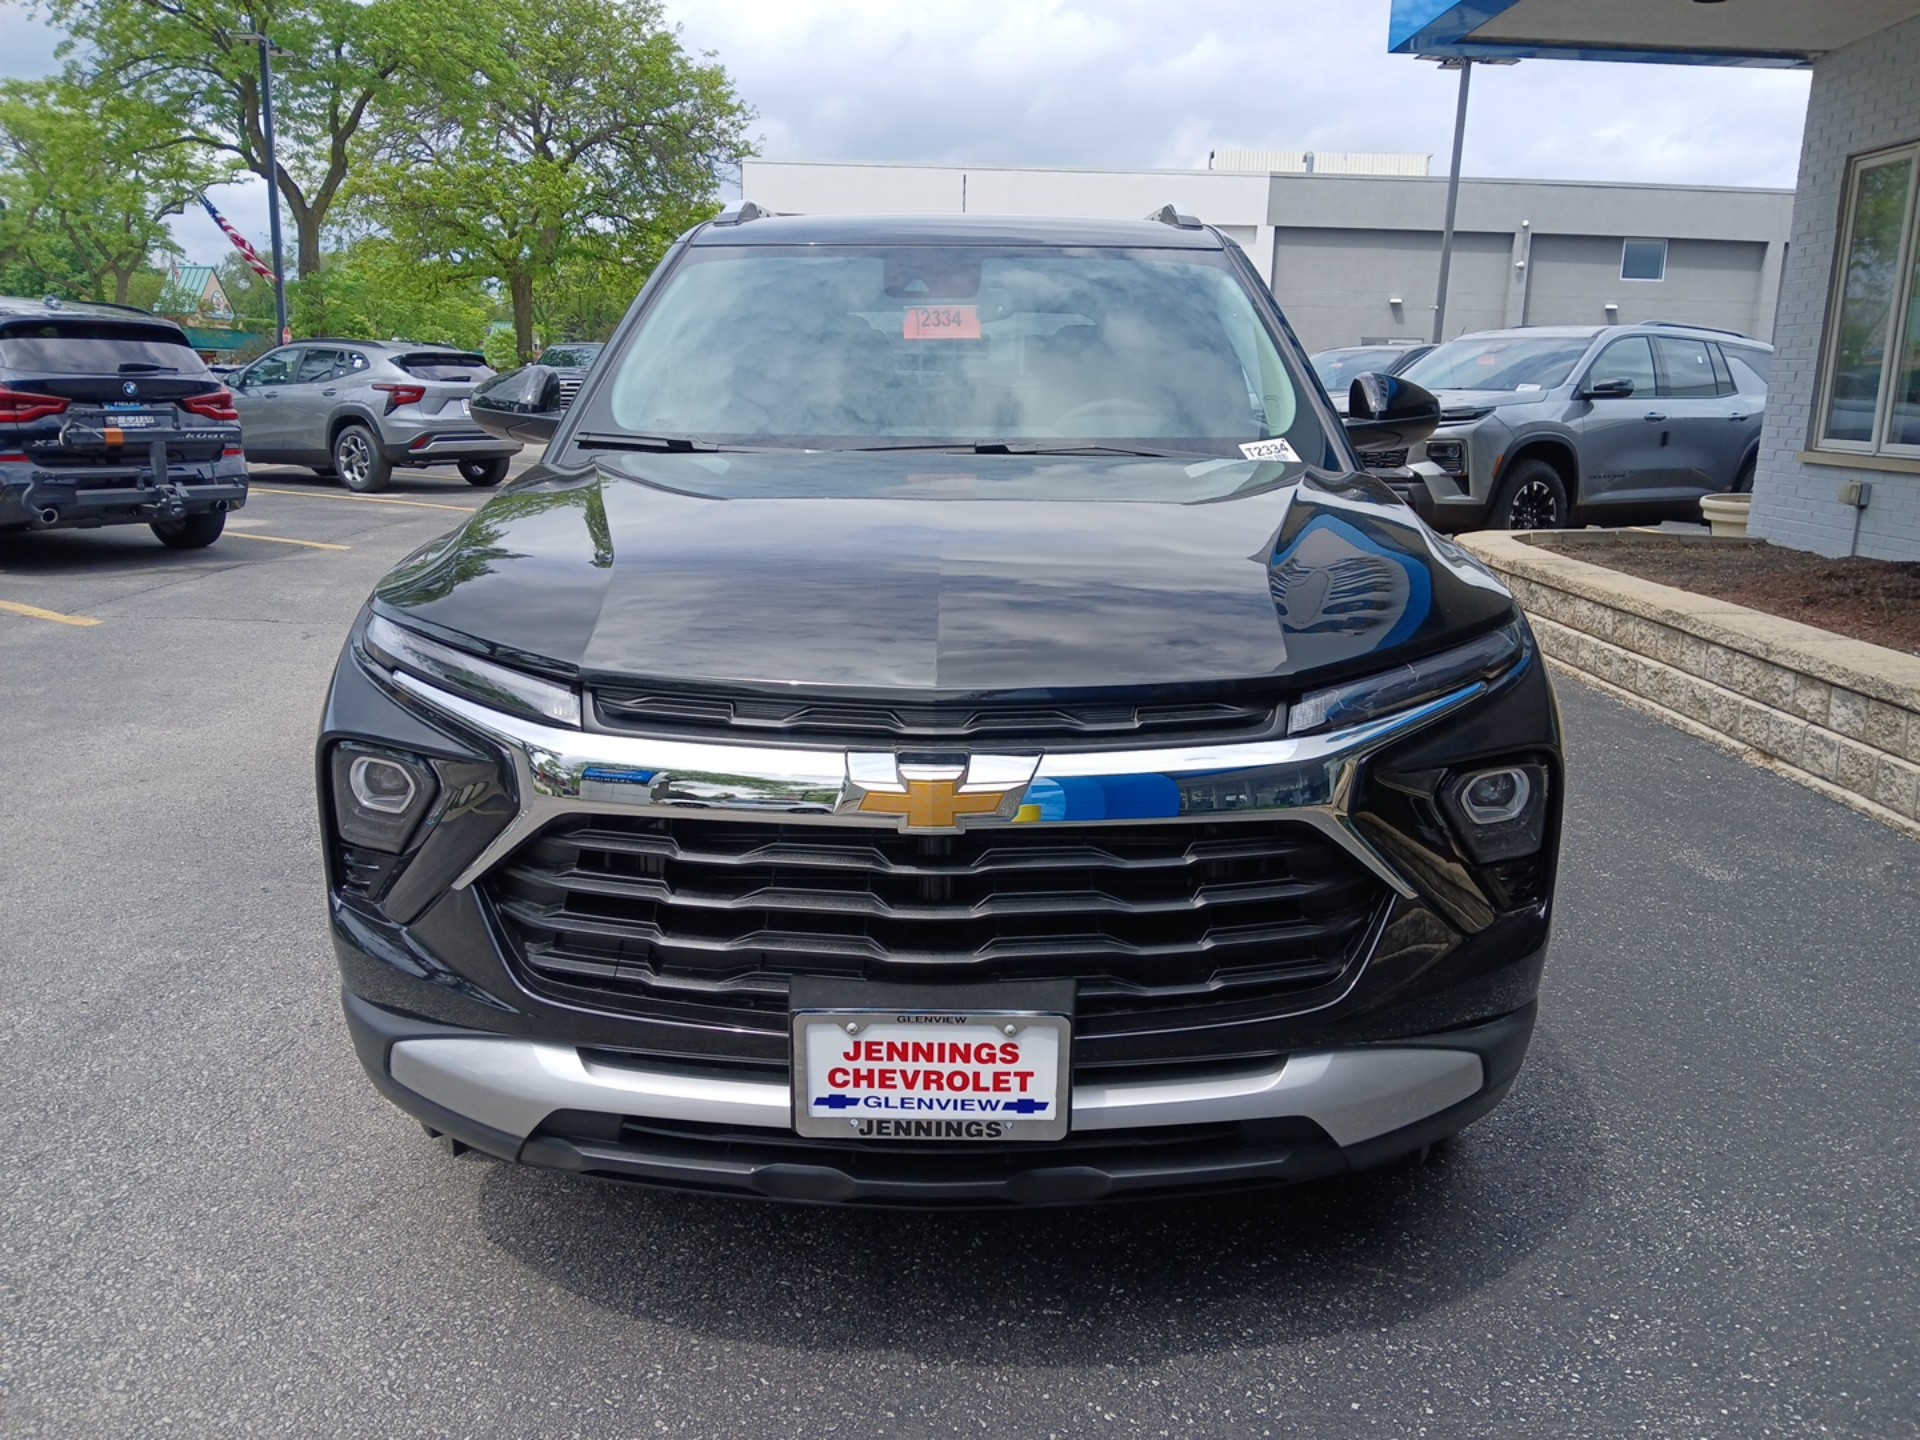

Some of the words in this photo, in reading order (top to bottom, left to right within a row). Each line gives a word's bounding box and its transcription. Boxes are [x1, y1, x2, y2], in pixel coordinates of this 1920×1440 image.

[921, 309, 962, 327] 2334
[1244, 443, 1289, 458] T2334
[897, 1015, 967, 1025] GLENVIEW
[843, 1041, 1020, 1065] JENNINGS
[828, 1067, 1034, 1092] CHEVROLET
[864, 1096, 1001, 1112] GLENVIEW
[859, 1120, 1003, 1138] JENNINGS
